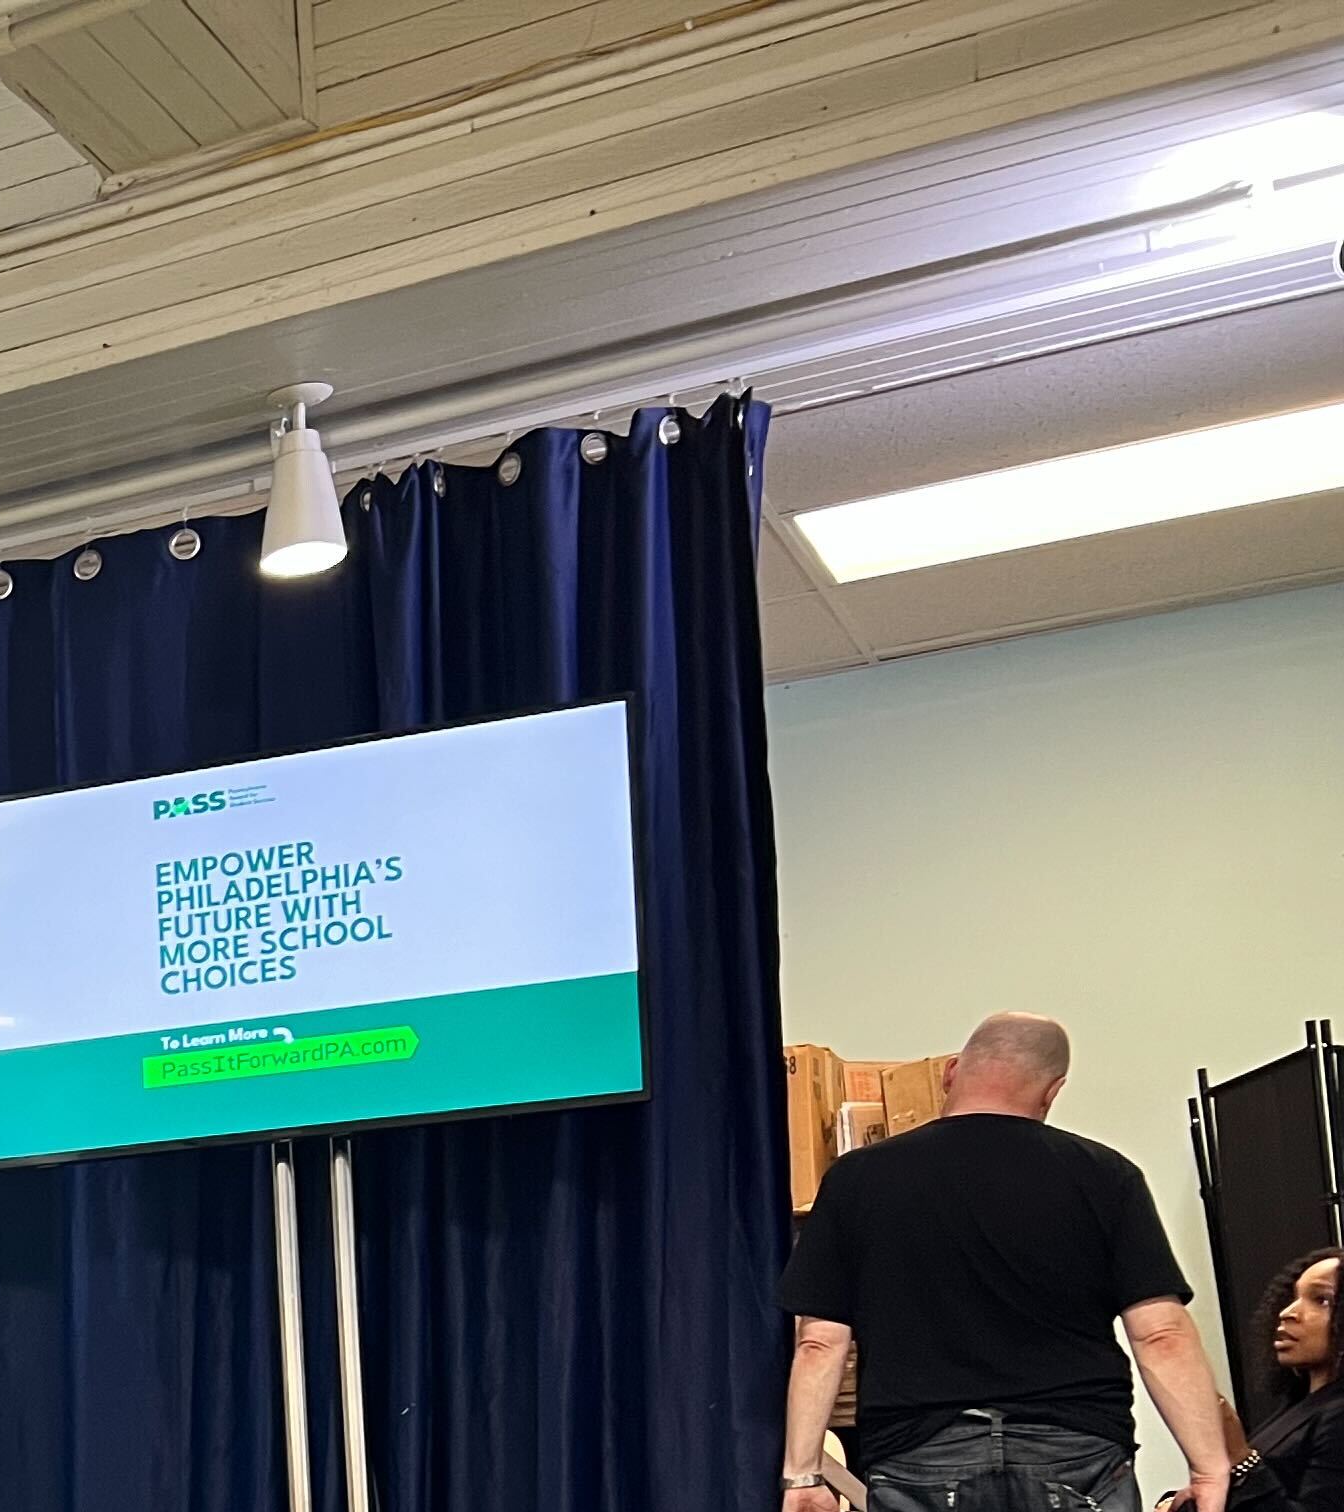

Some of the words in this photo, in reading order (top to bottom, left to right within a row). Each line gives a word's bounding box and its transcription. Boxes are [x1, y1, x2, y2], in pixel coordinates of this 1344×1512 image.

[153, 790, 227, 820] PASS
[155, 841, 315, 887] EMPOWER
[156, 856, 403, 914] PHILADELPHIA'S
[158, 903, 271, 942] FUTURE
[281, 890, 362, 924] WITH
[159, 934, 250, 969] MORE
[260, 915, 393, 955] SCHOOL
[160, 955, 297, 995] CHOICES
[160, 1035, 179, 1050] To
[182, 1032, 226, 1049] Learn
[228, 1027, 268, 1043] More
[162, 1037, 407, 1080] PassItForwardPA.com
